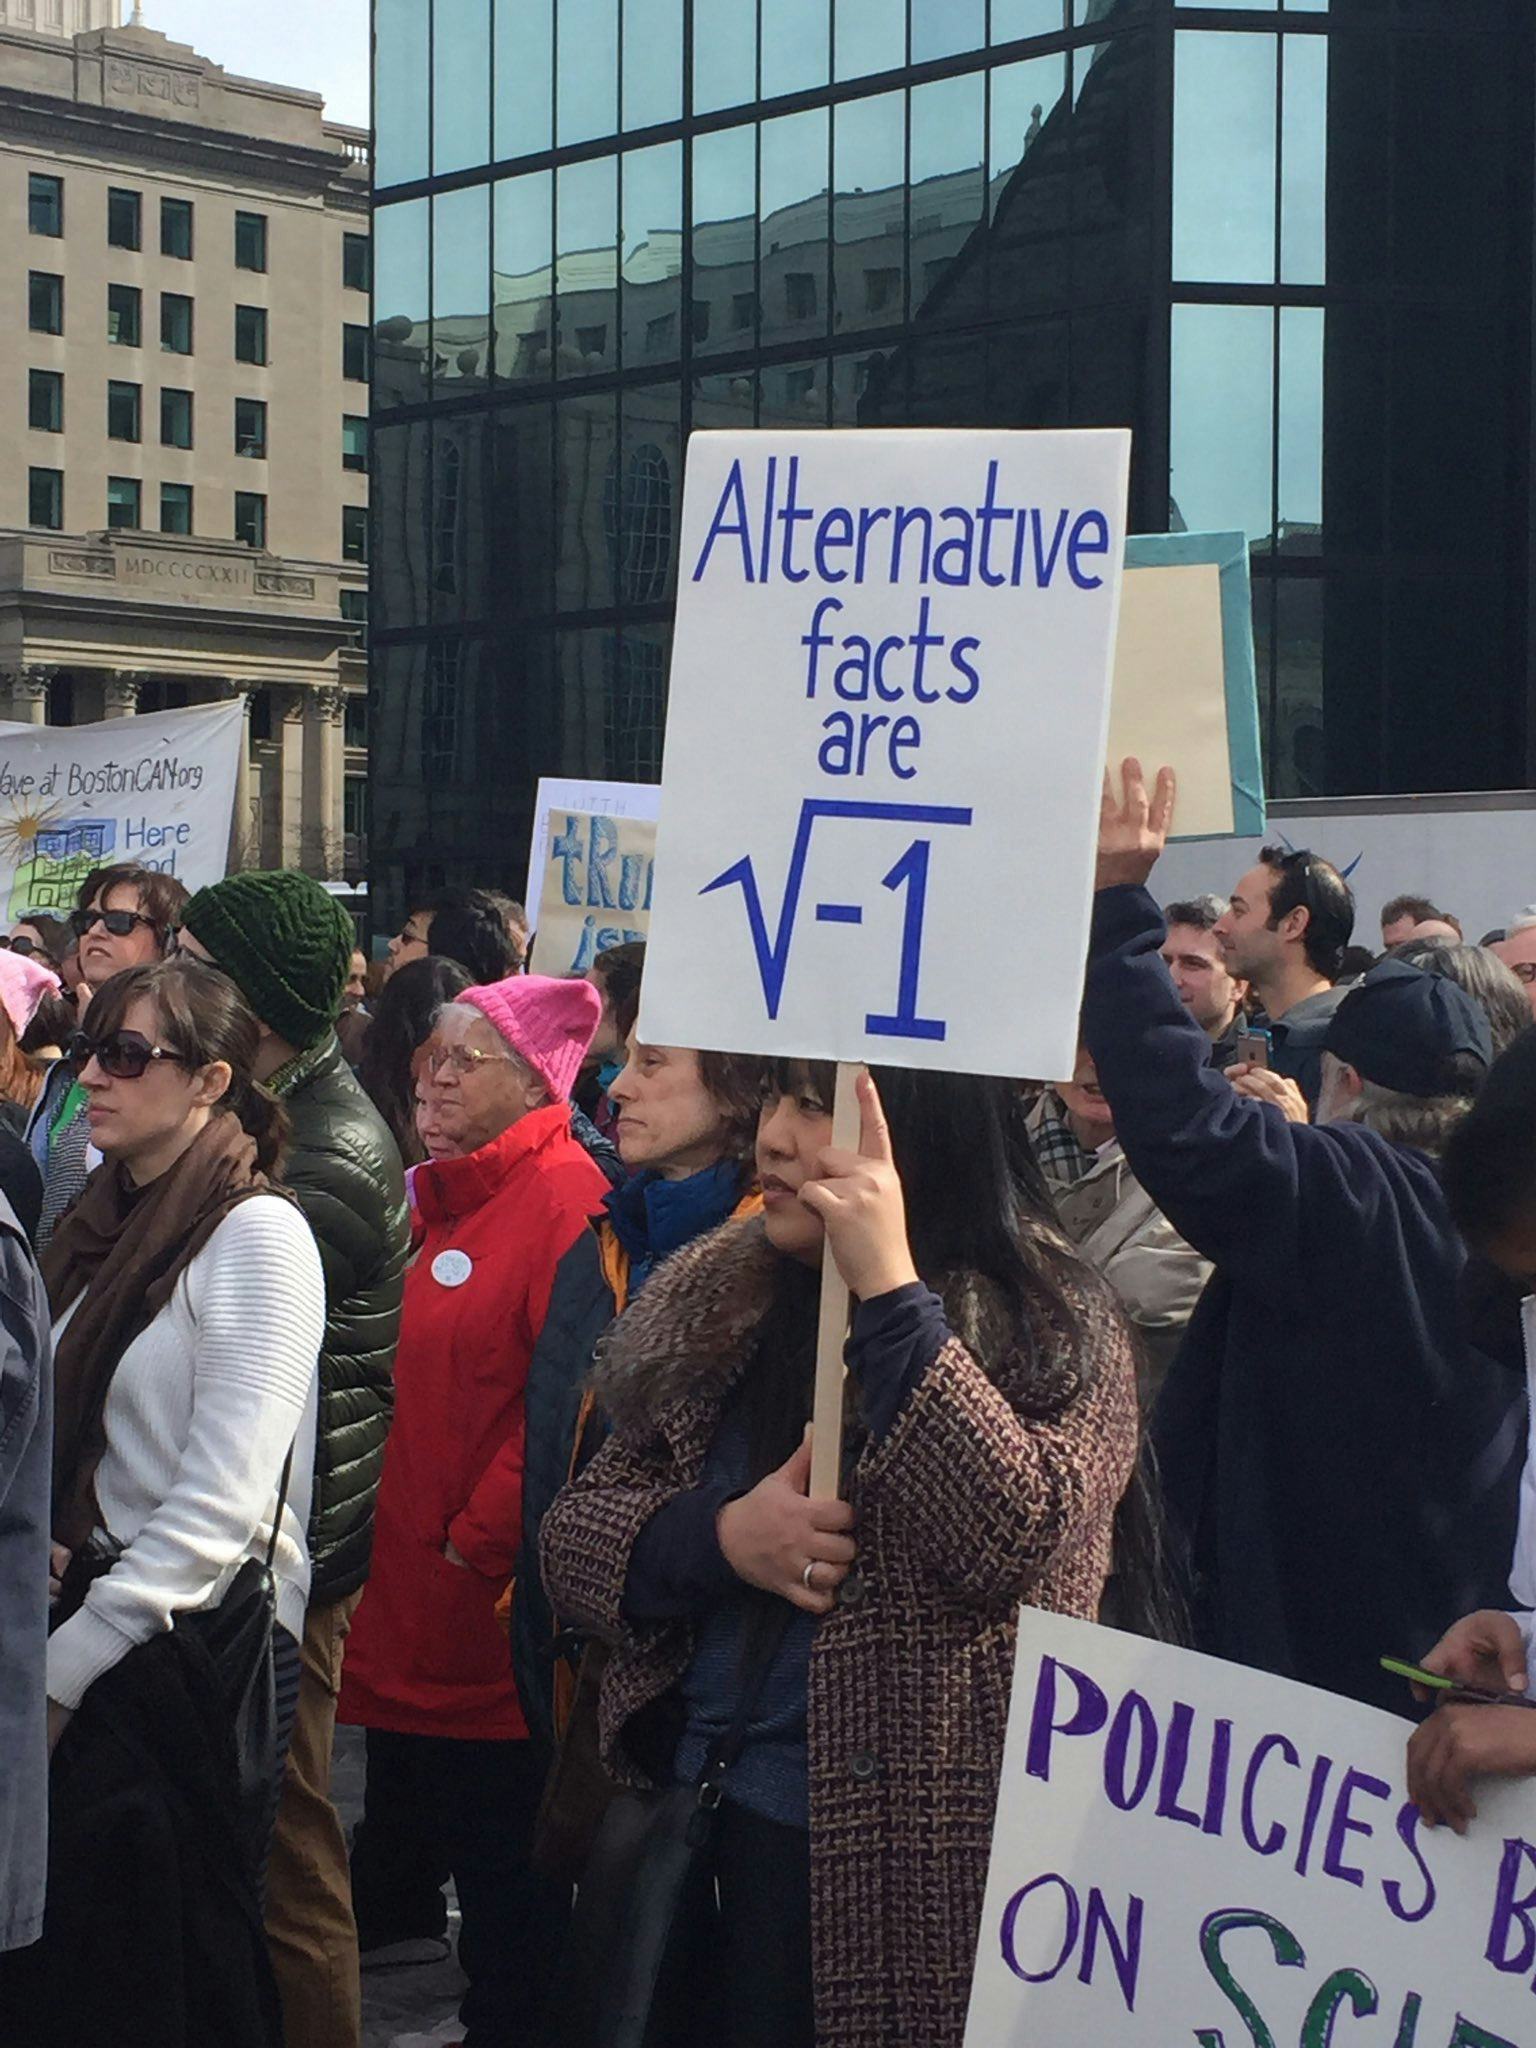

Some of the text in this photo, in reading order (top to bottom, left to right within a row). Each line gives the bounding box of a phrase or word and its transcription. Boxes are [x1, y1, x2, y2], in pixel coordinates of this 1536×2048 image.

[692, 456, 1110, 590] Alternative
[802, 596, 981, 704] facts
[39, 763, 62, 796] at
[818, 710, 922, 780] are
[125, 817, 191, 849] Here
[1026, 1654, 1437, 1923] POLICIES
[1000, 1872, 1145, 2013] ON
